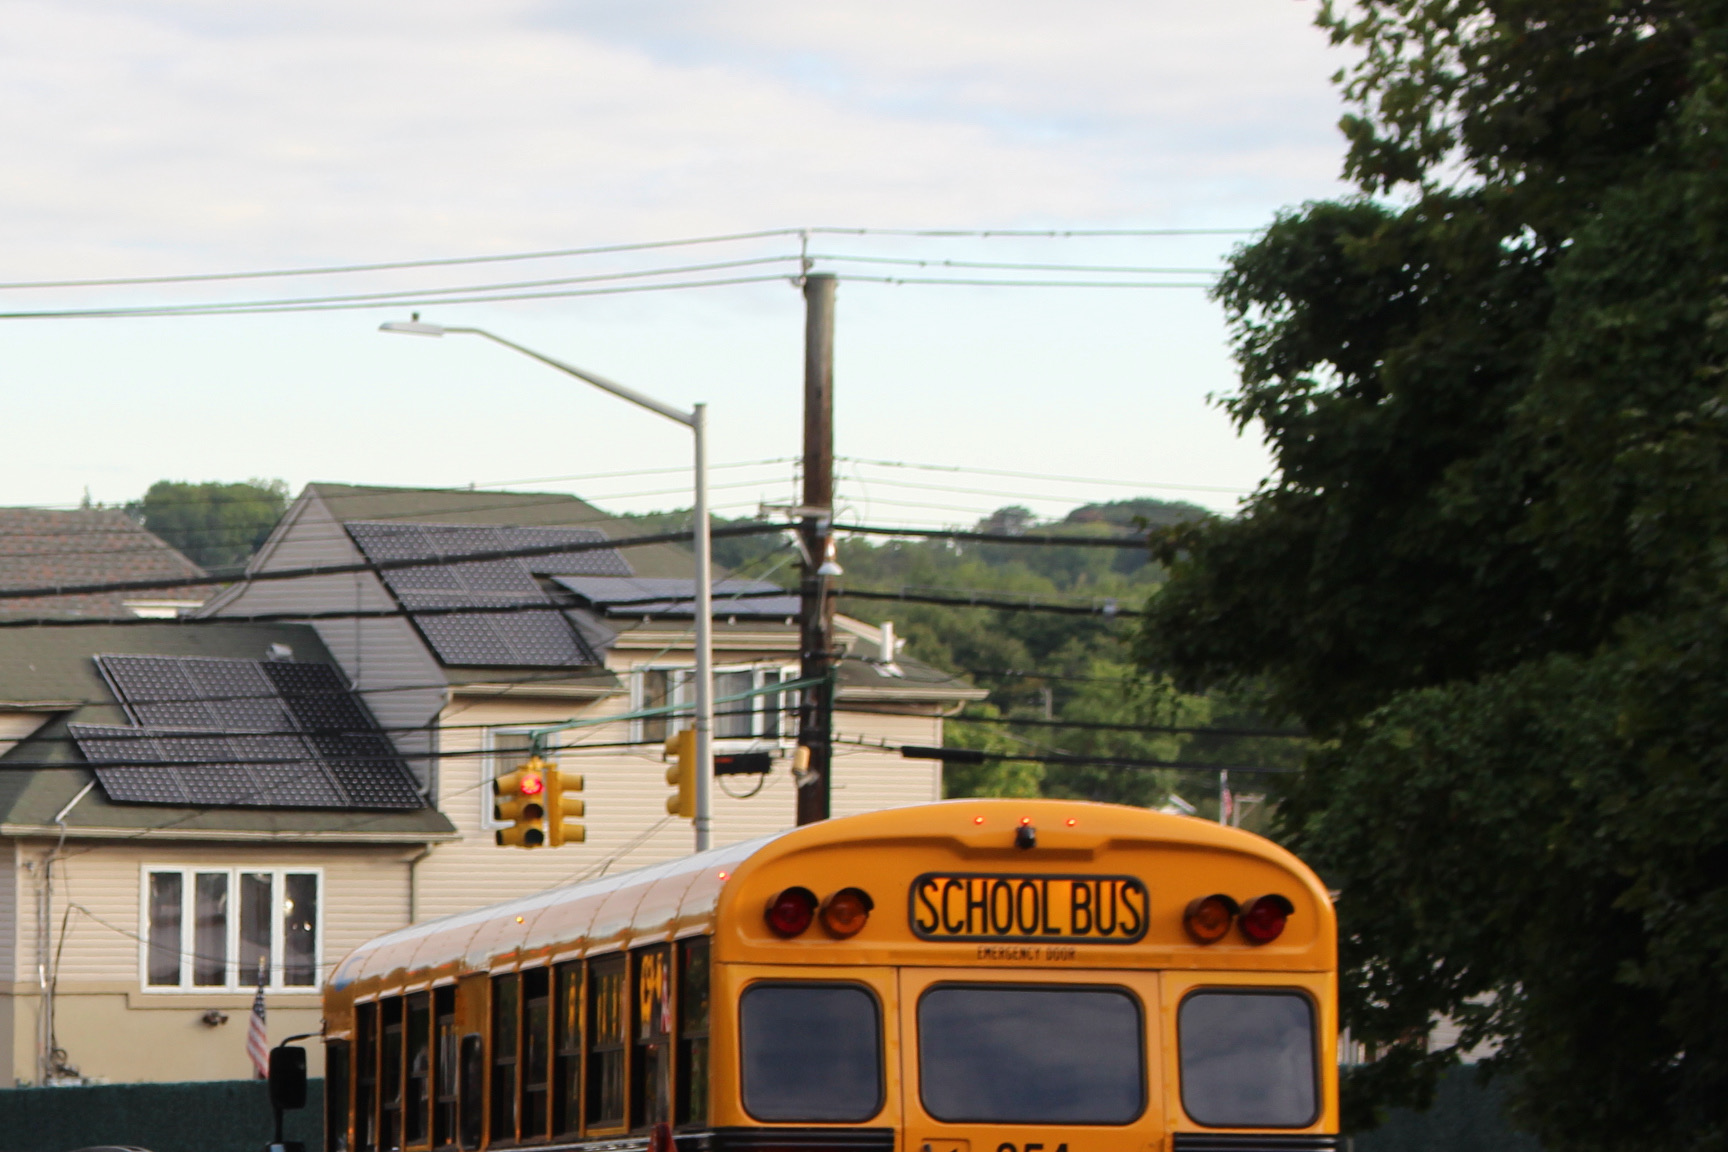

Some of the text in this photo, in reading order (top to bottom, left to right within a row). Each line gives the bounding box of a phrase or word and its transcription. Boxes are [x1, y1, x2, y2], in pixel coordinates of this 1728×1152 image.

[916, 879, 1142, 936] SCHOOL BUS
[976, 946, 1076, 962] EMERGENCY DOOR
